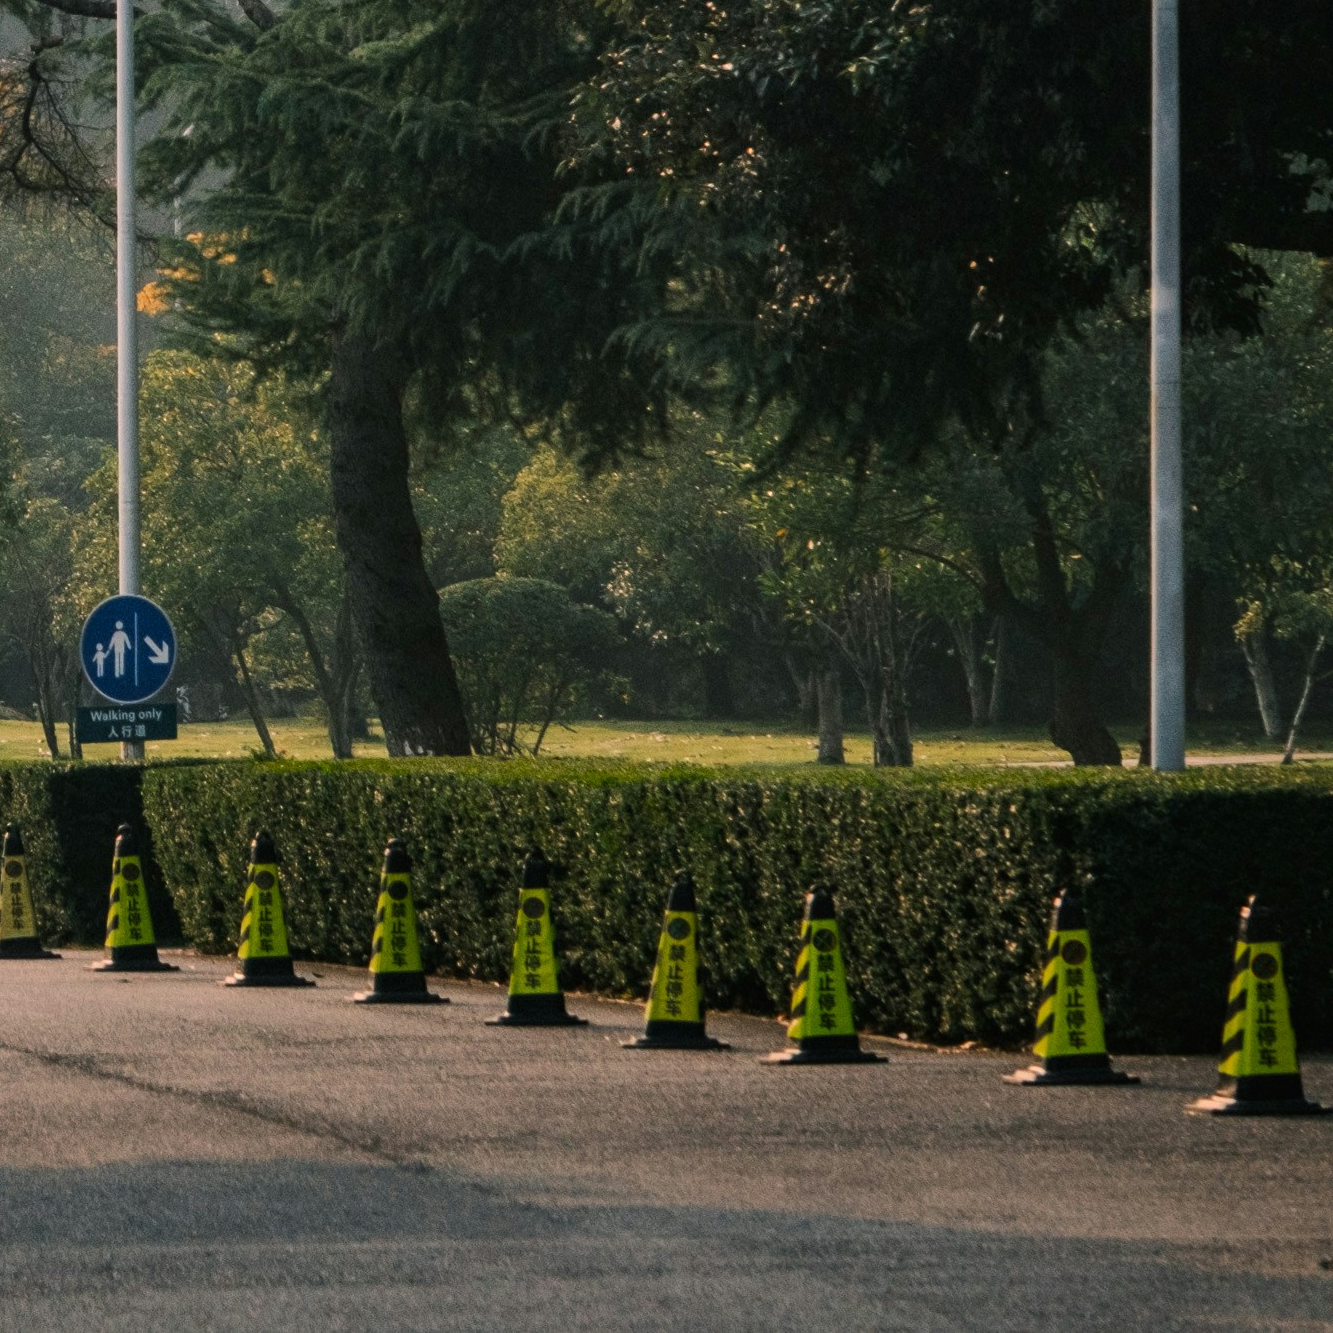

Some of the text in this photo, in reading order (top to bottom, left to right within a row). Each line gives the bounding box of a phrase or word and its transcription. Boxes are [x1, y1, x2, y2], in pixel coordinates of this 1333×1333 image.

[90, 707, 163, 723] Walking only
[108, 724, 146, 738] 人行道
[9, 882, 24, 931] 禁止停车
[125, 882, 142, 941] 禁止停车
[258, 891, 274, 953] 禁止停车
[390, 903, 407, 967] 禁止停车
[524, 920, 542, 989] 禁止停车
[665, 945, 686, 1017] 禁止停车
[817, 954, 836, 1031] 禁止停车
[1065, 968, 1088, 1050] 禁止停车
[1256, 982, 1279, 1068] 禁止停车
